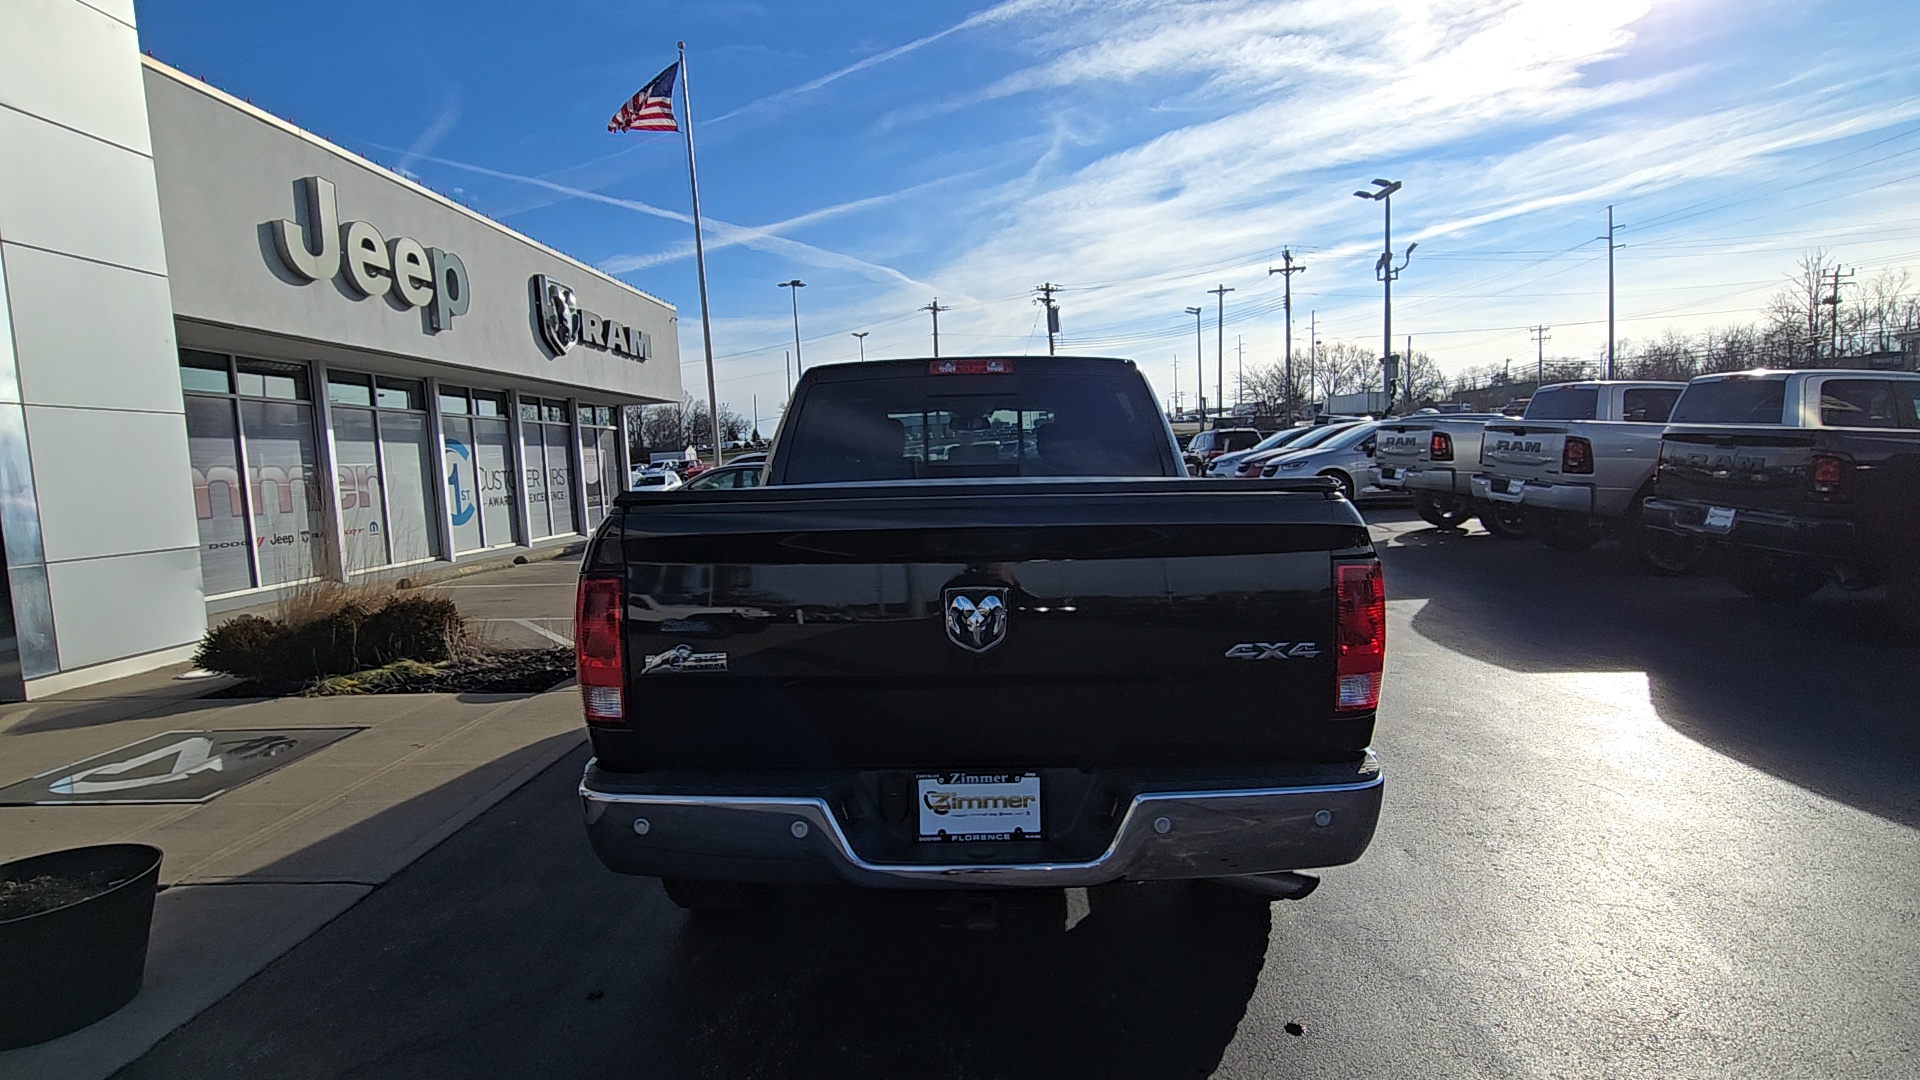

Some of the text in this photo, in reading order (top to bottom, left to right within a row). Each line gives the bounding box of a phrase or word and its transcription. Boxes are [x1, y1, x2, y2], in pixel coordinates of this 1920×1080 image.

[272, 176, 470, 331] Jeep
[579, 309, 652, 361] RAM
[1385, 436, 1417, 447] RAM
[1497, 440, 1542, 453] RAM
[1686, 453, 1766, 471] RAM
[479, 466, 541, 491] CUSTOER
[488, 494, 513, 508] AWARD
[208, 540, 250, 550] DODG
[269, 532, 295, 546] Jeep
[949, 772, 1009, 784] Zimmer
[930, 792, 1036, 812] Zimmer
[951, 833, 1011, 842] FLORENCE
